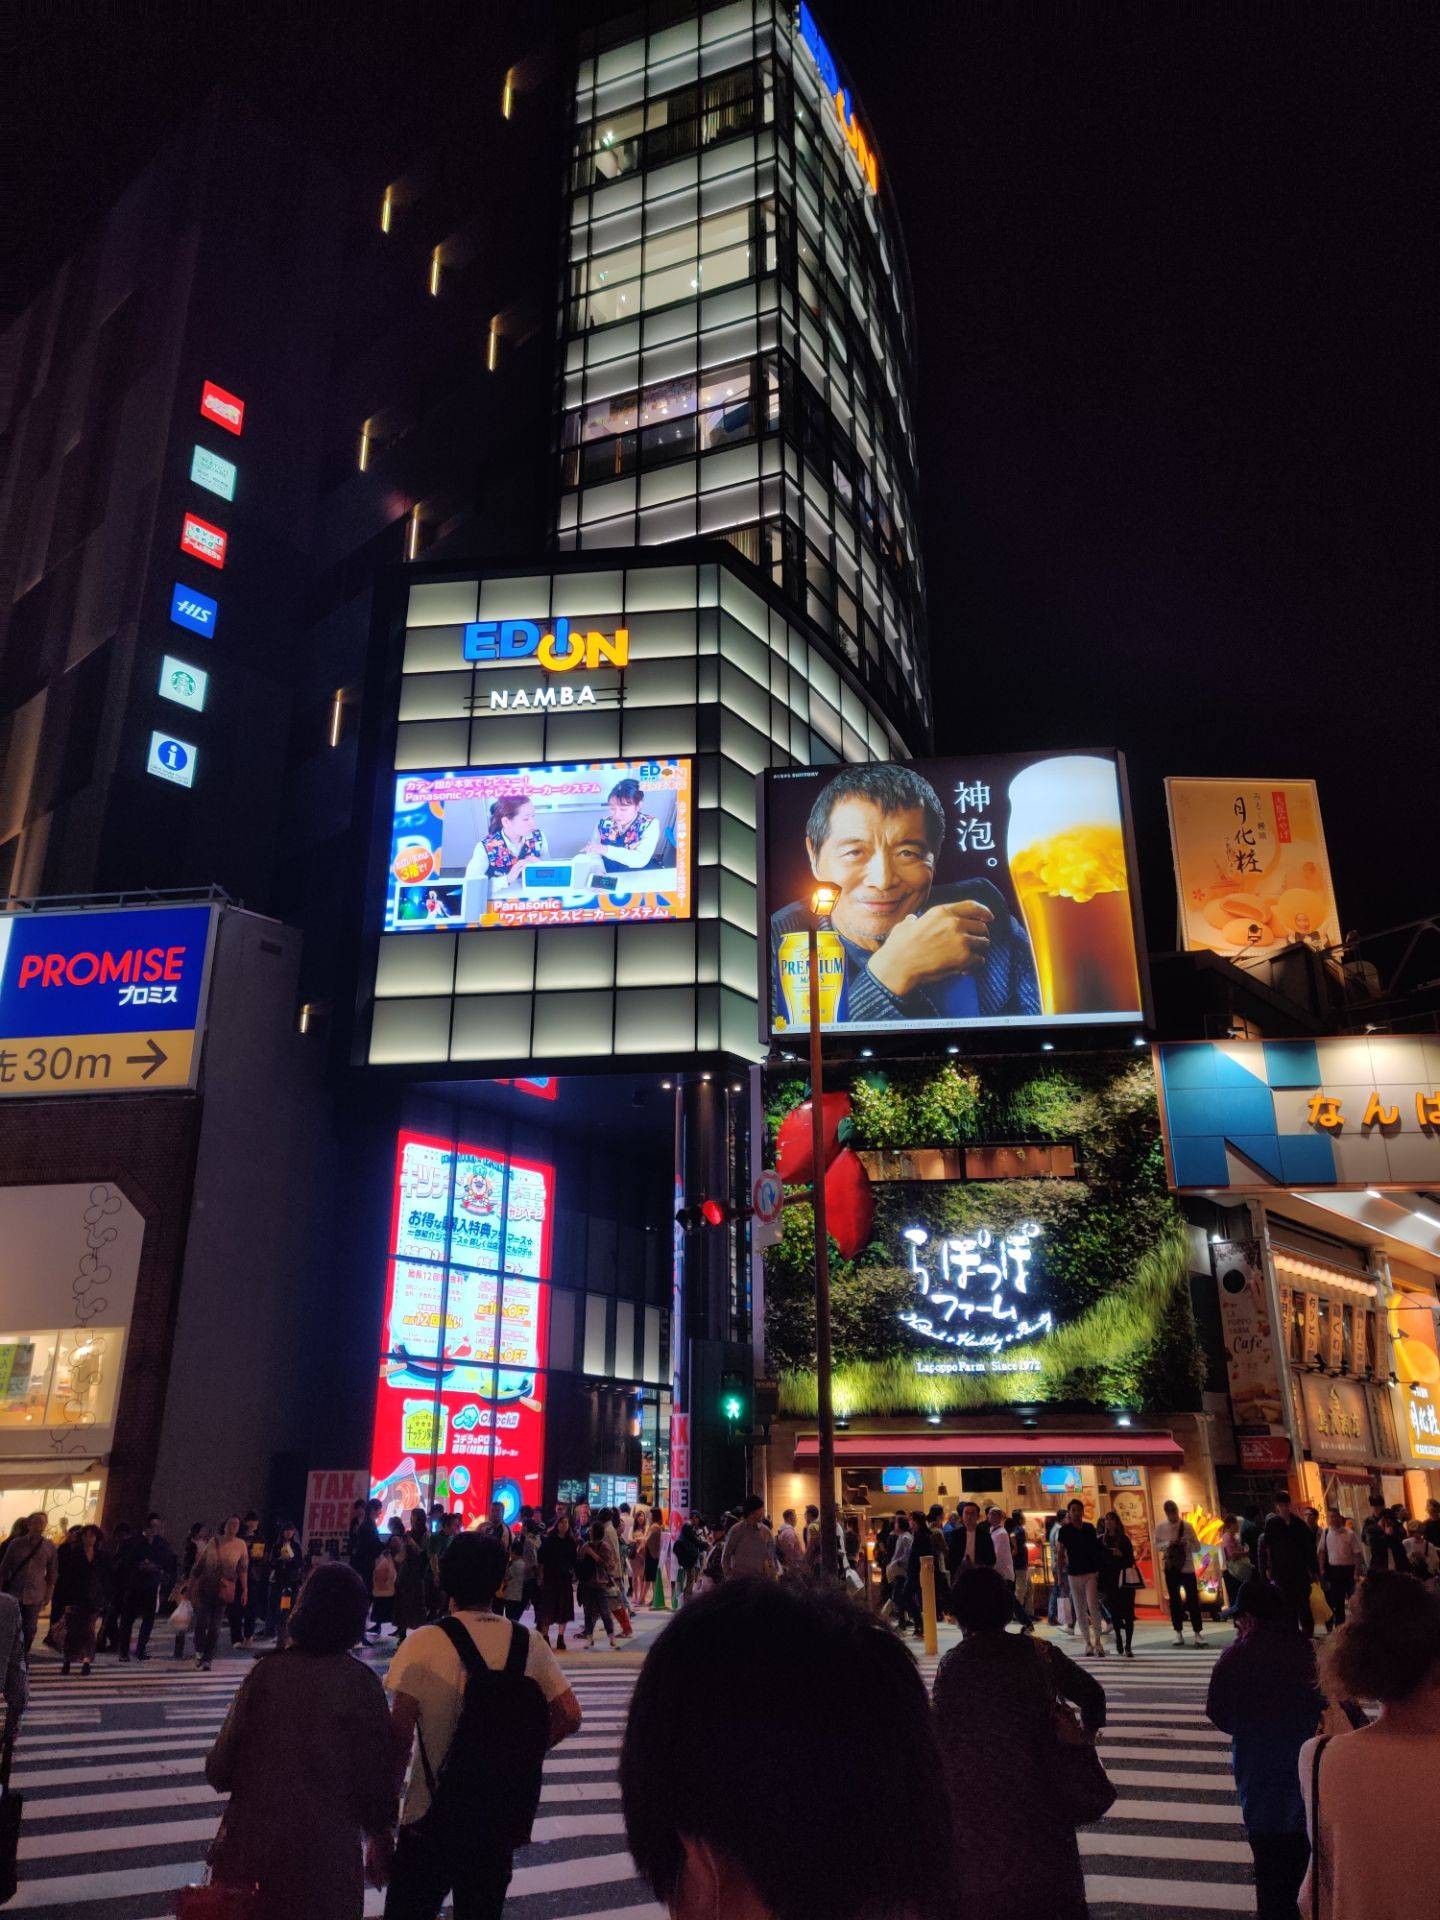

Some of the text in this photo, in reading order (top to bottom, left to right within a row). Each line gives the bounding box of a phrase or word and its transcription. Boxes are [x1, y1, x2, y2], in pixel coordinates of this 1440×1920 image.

[176, 600, 212, 623] HIS
[464, 617, 630, 671] EDION
[490, 685, 597, 710] NAMBA
[494, 899, 560, 912] Panasonic
[18, 946, 187, 989] PROMISE
[118, 985, 178, 1006] プロミス
[1232, 1335, 1264, 1354] Cafe
[916, 1360, 1041, 1374] Lapoppo Farm Since 1972
[312, 1473, 356, 1499] TAX
